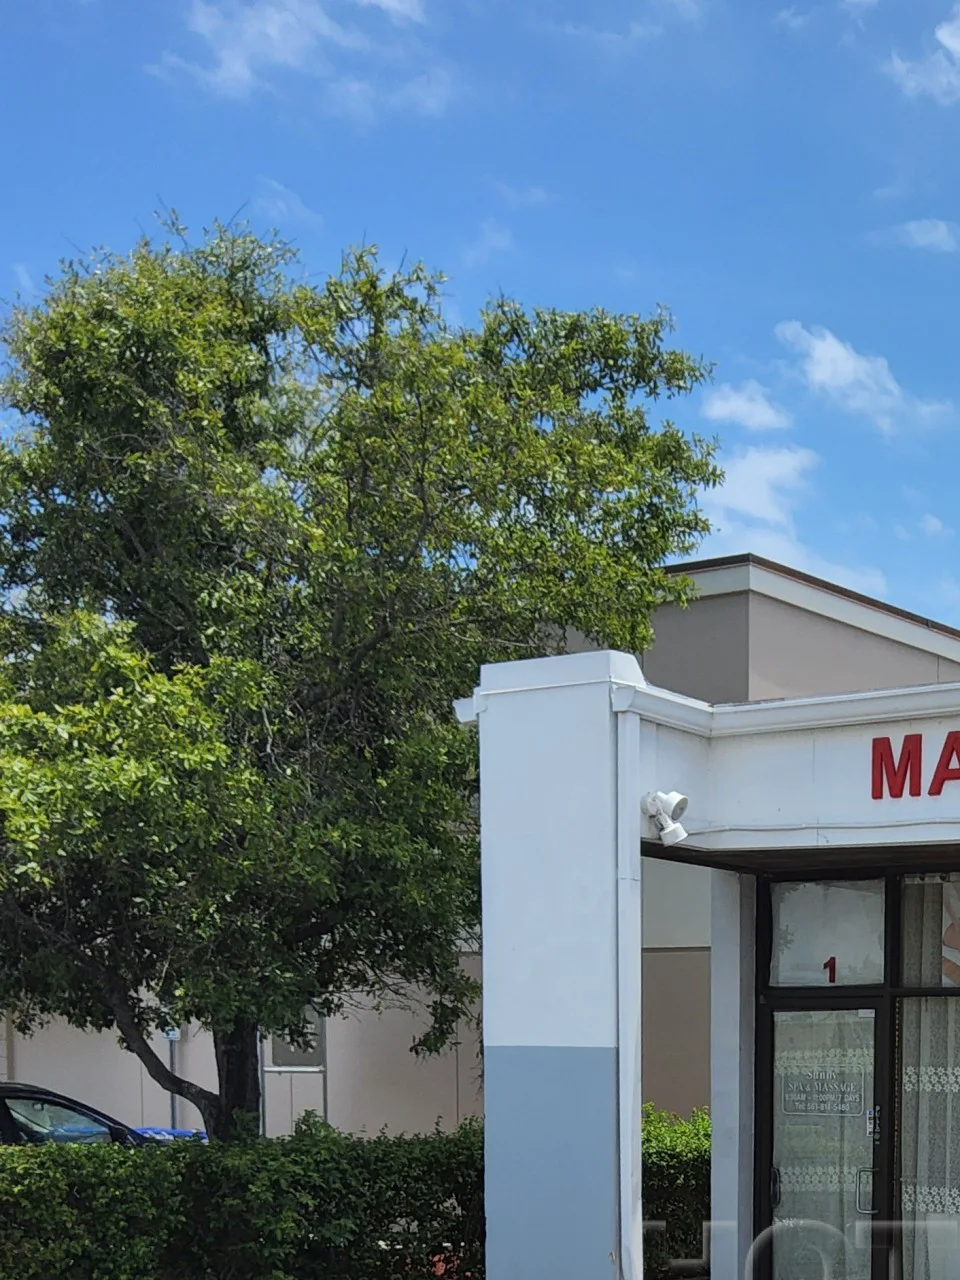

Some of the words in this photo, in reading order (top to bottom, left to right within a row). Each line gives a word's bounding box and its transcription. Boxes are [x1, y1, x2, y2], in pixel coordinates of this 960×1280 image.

[823, 956, 836, 983] 1
[788, 1082, 803, 1091] SPA
[814, 1082, 857, 1092] MASSAGE
